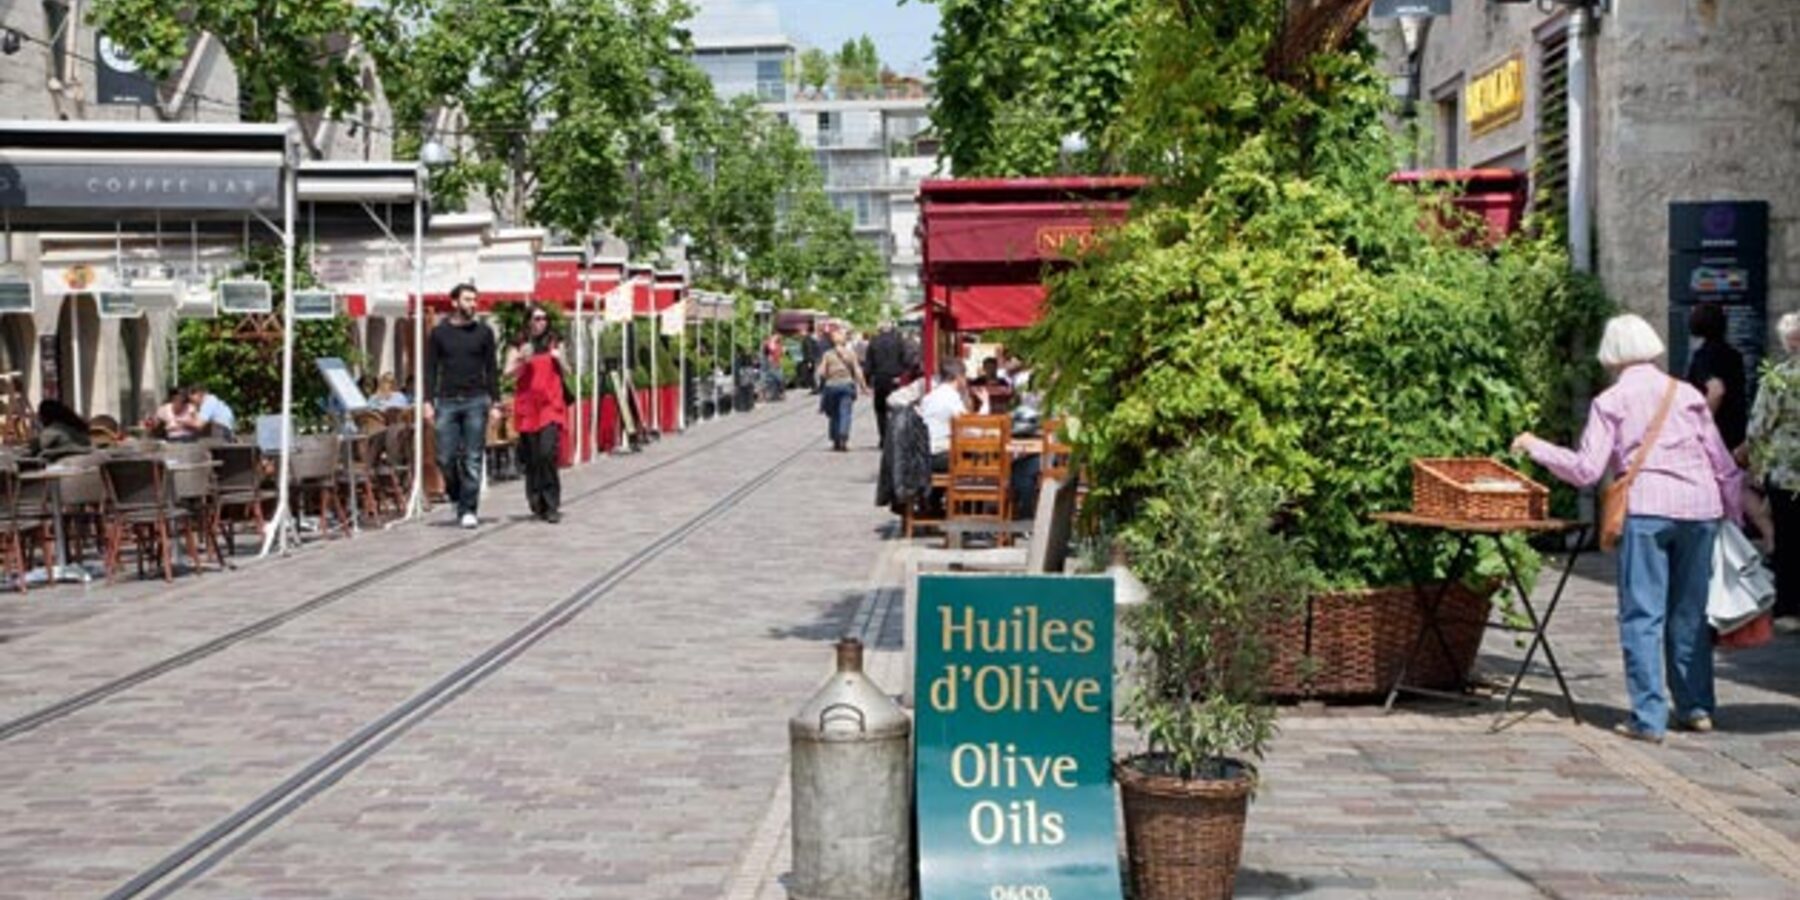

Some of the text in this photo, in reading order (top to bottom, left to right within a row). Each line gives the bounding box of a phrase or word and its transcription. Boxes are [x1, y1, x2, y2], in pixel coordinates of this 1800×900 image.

[86, 177, 256, 193] COFFEE BAR
[937, 605, 1096, 653] Huiles
[930, 664, 1100, 713] d’Olive
[951, 742, 1078, 788] Olive
[969, 800, 1066, 845] Oils
